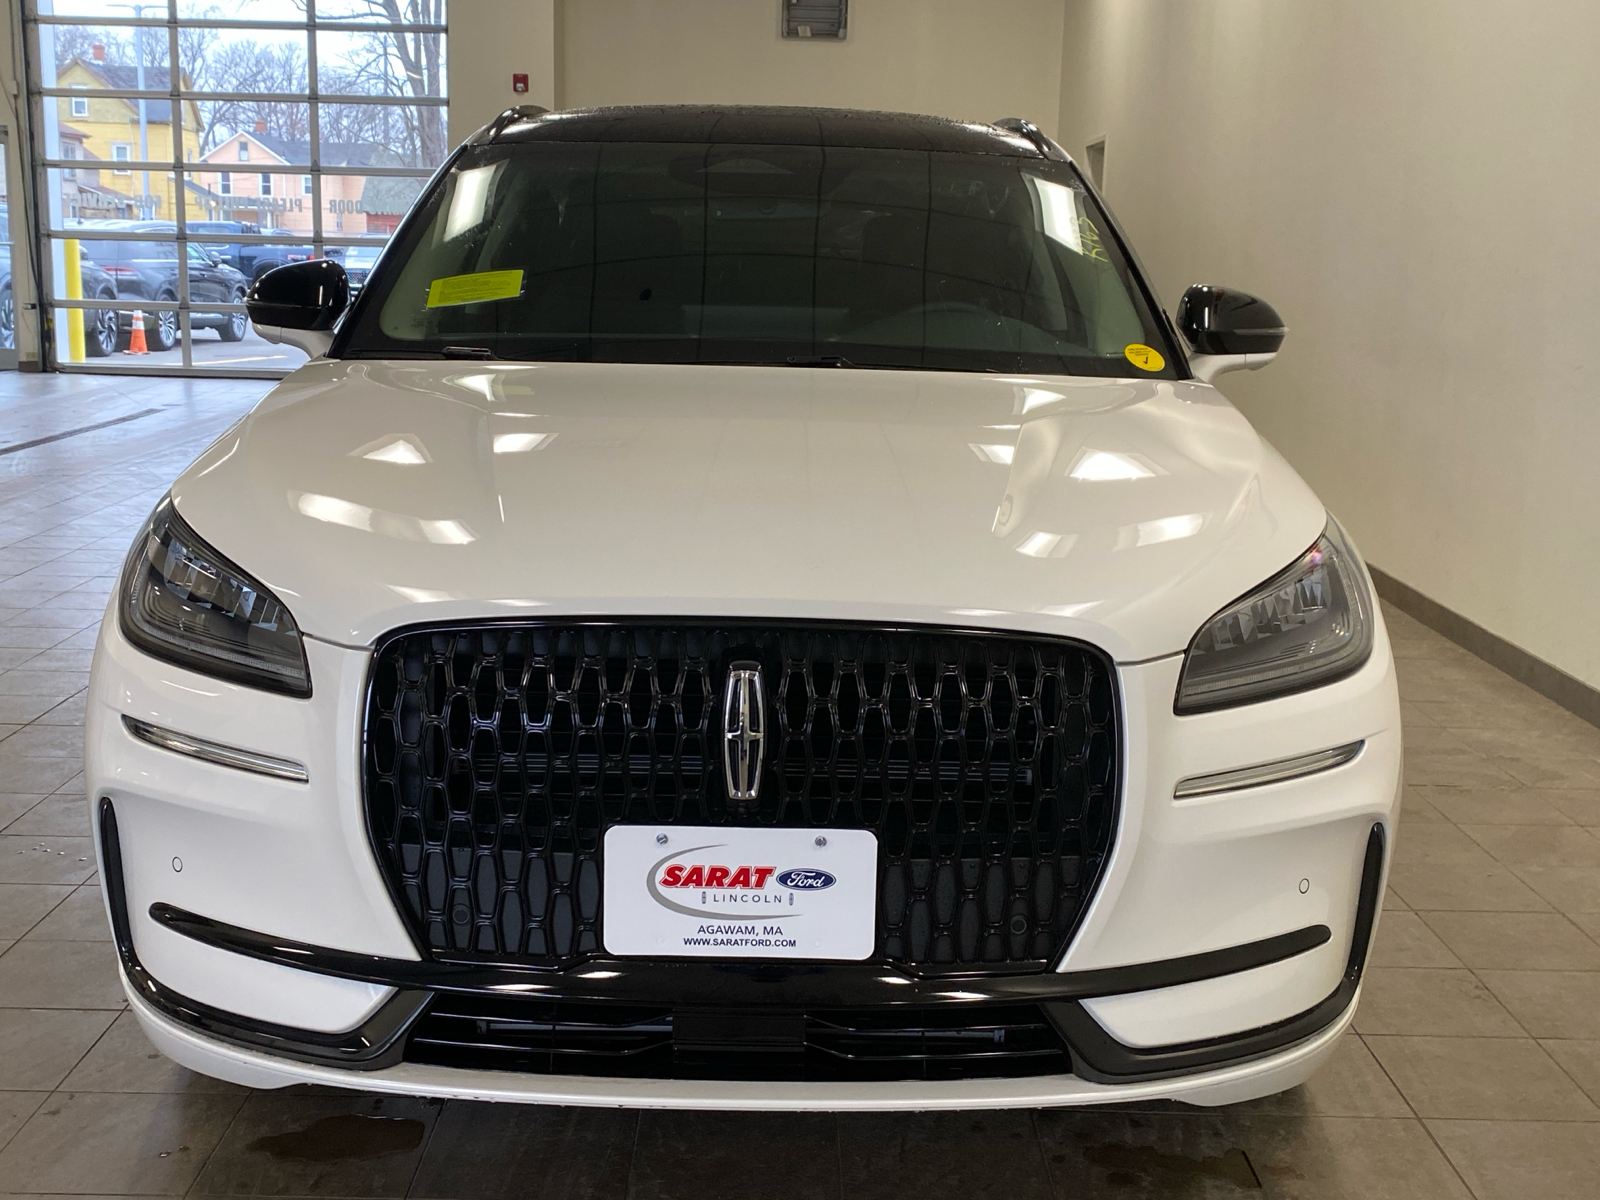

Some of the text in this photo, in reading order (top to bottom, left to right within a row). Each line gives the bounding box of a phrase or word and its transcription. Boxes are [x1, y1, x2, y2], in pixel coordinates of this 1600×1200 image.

[659, 863, 824, 890] SARAT Ford
[713, 893, 782, 904] LINCOLN
[697, 925, 783, 936] AGAWAM, MA
[683, 938, 796, 948] WWW.SARATFORD.COM
